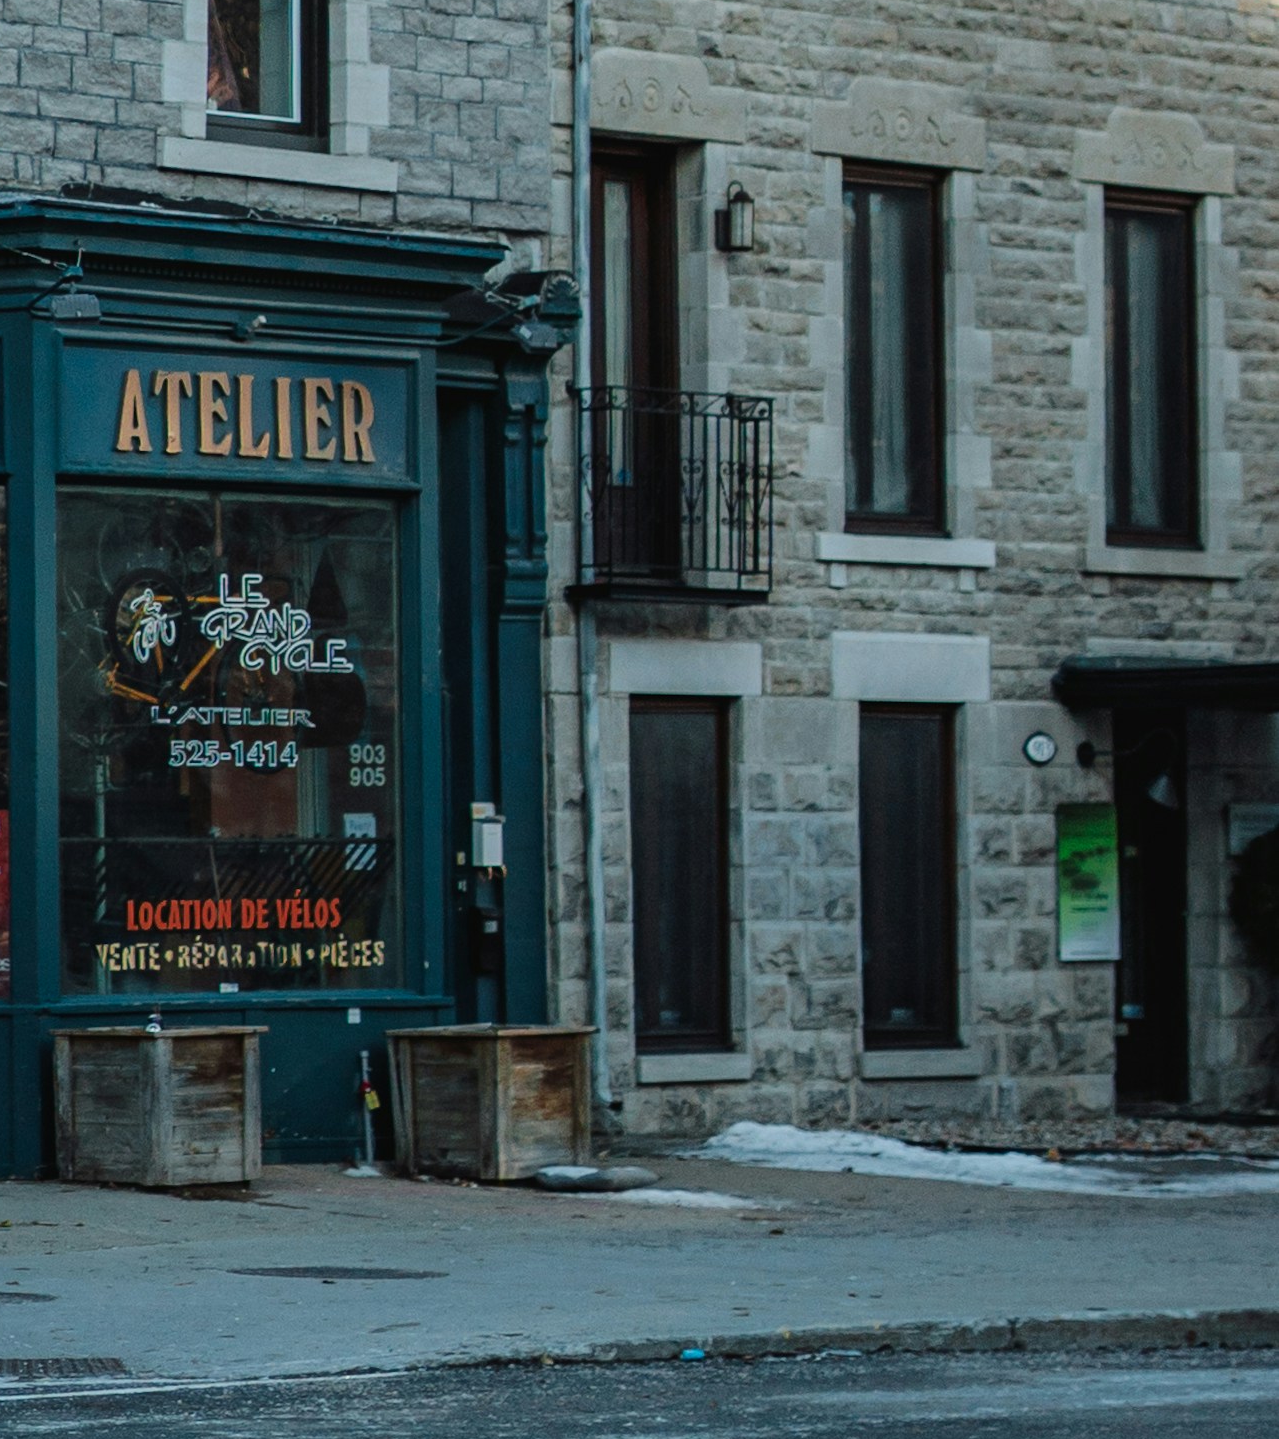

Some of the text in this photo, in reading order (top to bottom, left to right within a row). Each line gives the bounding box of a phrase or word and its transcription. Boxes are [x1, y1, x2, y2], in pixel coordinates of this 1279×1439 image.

[115, 368, 377, 463] ATELIER
[219, 573, 270, 608] LE
[200, 602, 312, 649] GRAND
[239, 638, 355, 675] CYCLE
[150, 706, 316, 728] L'ATELIER
[167, 739, 299, 768] 525-1414
[349, 743, 385, 764] 903
[349, 766, 386, 787] 905
[126, 889, 341, 931] LOCATION DE VÉLOS
[95, 942, 161, 971] VENTE
[319, 933, 386, 968] PIÈCES
